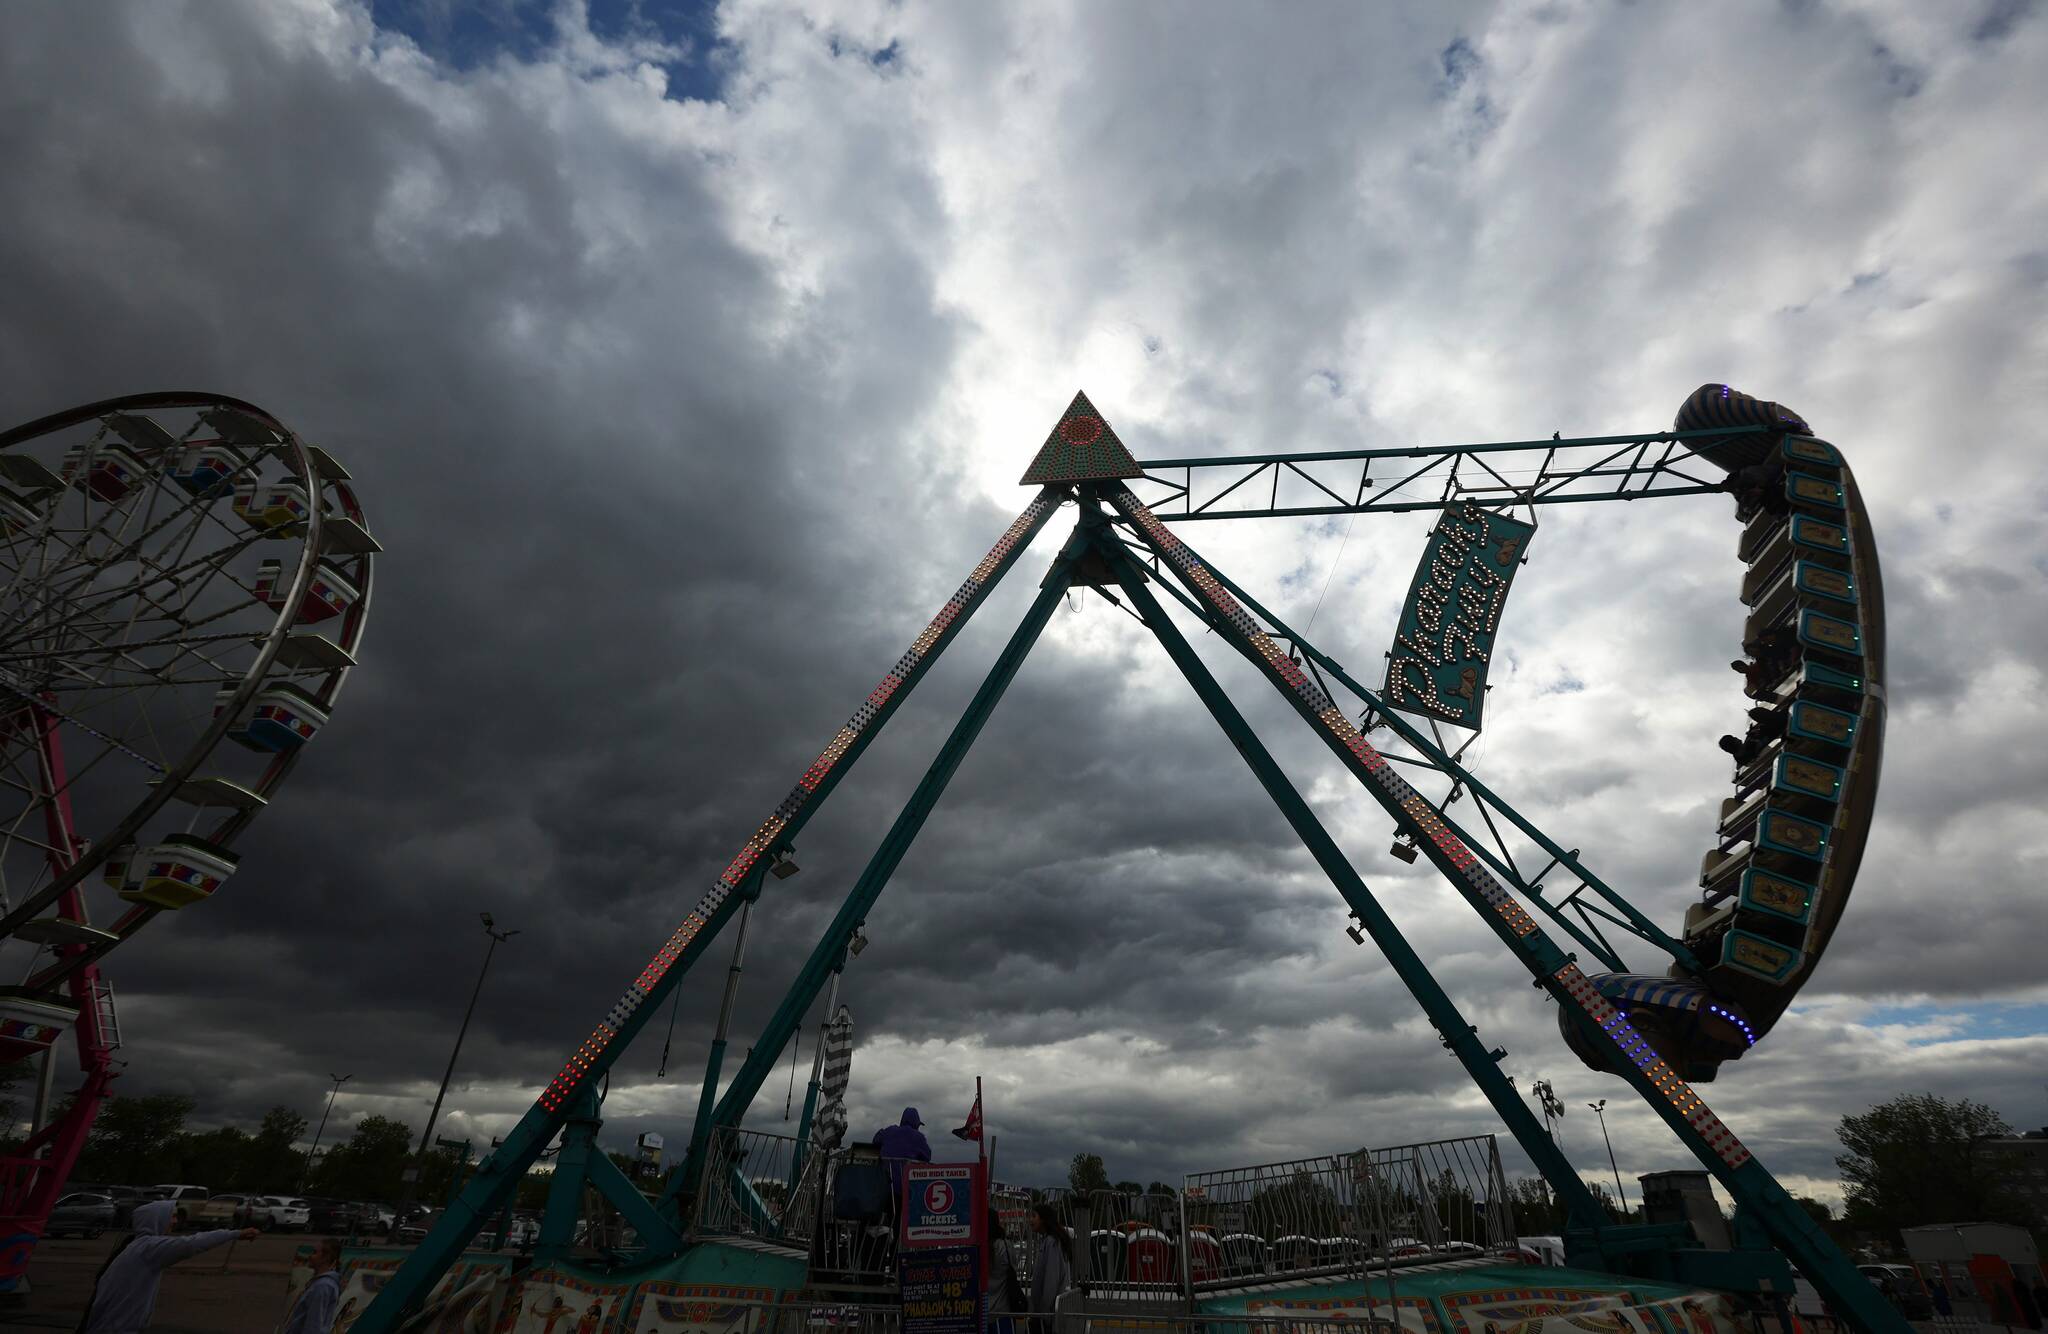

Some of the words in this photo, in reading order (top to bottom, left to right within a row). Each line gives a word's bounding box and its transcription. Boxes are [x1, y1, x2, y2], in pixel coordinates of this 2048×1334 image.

[1443, 555, 1507, 664] Fury
[912, 1171, 928, 1179] THIS
[929, 1170, 944, 1178] RIDE
[931, 1184, 948, 1210] 5
[920, 1214, 958, 1225] TICKETS
[904, 1298, 952, 1318] PHARAOH'S
[955, 1297, 976, 1316] FURY
